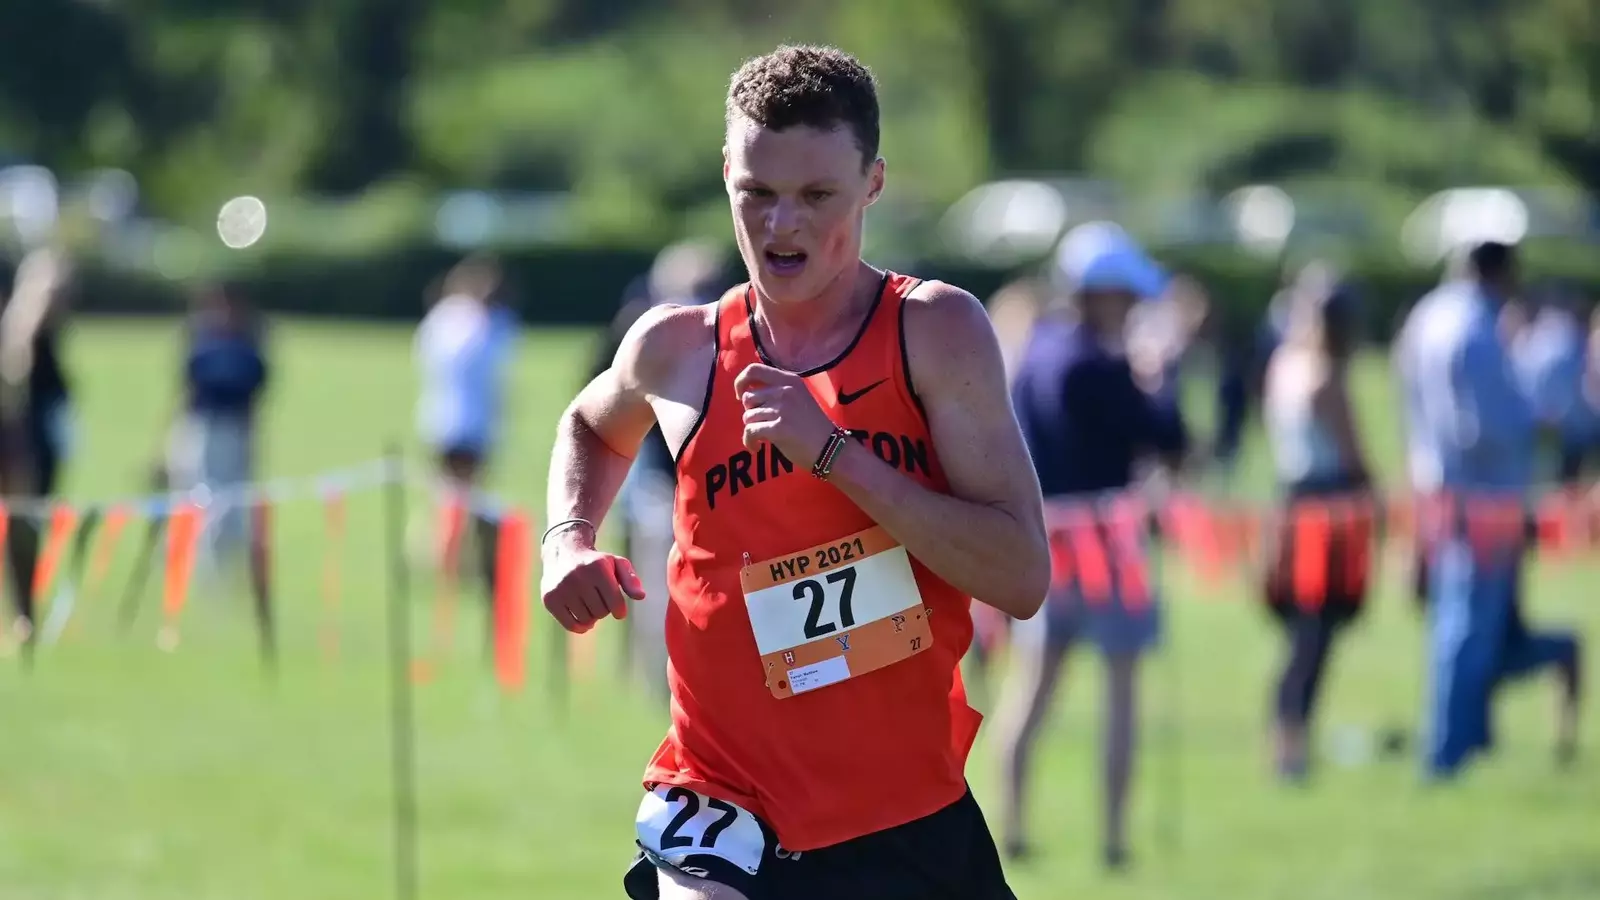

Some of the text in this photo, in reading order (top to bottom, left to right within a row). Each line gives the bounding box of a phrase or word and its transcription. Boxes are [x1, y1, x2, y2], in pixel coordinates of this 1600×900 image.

[705, 428, 932, 511] PRINTON
[769, 537, 865, 582] HYP 2021
[792, 566, 857, 639] 27
[784, 651, 794, 663] H
[836, 634, 850, 651] Y
[910, 637, 921, 651] 27
[660, 787, 738, 851] 27
